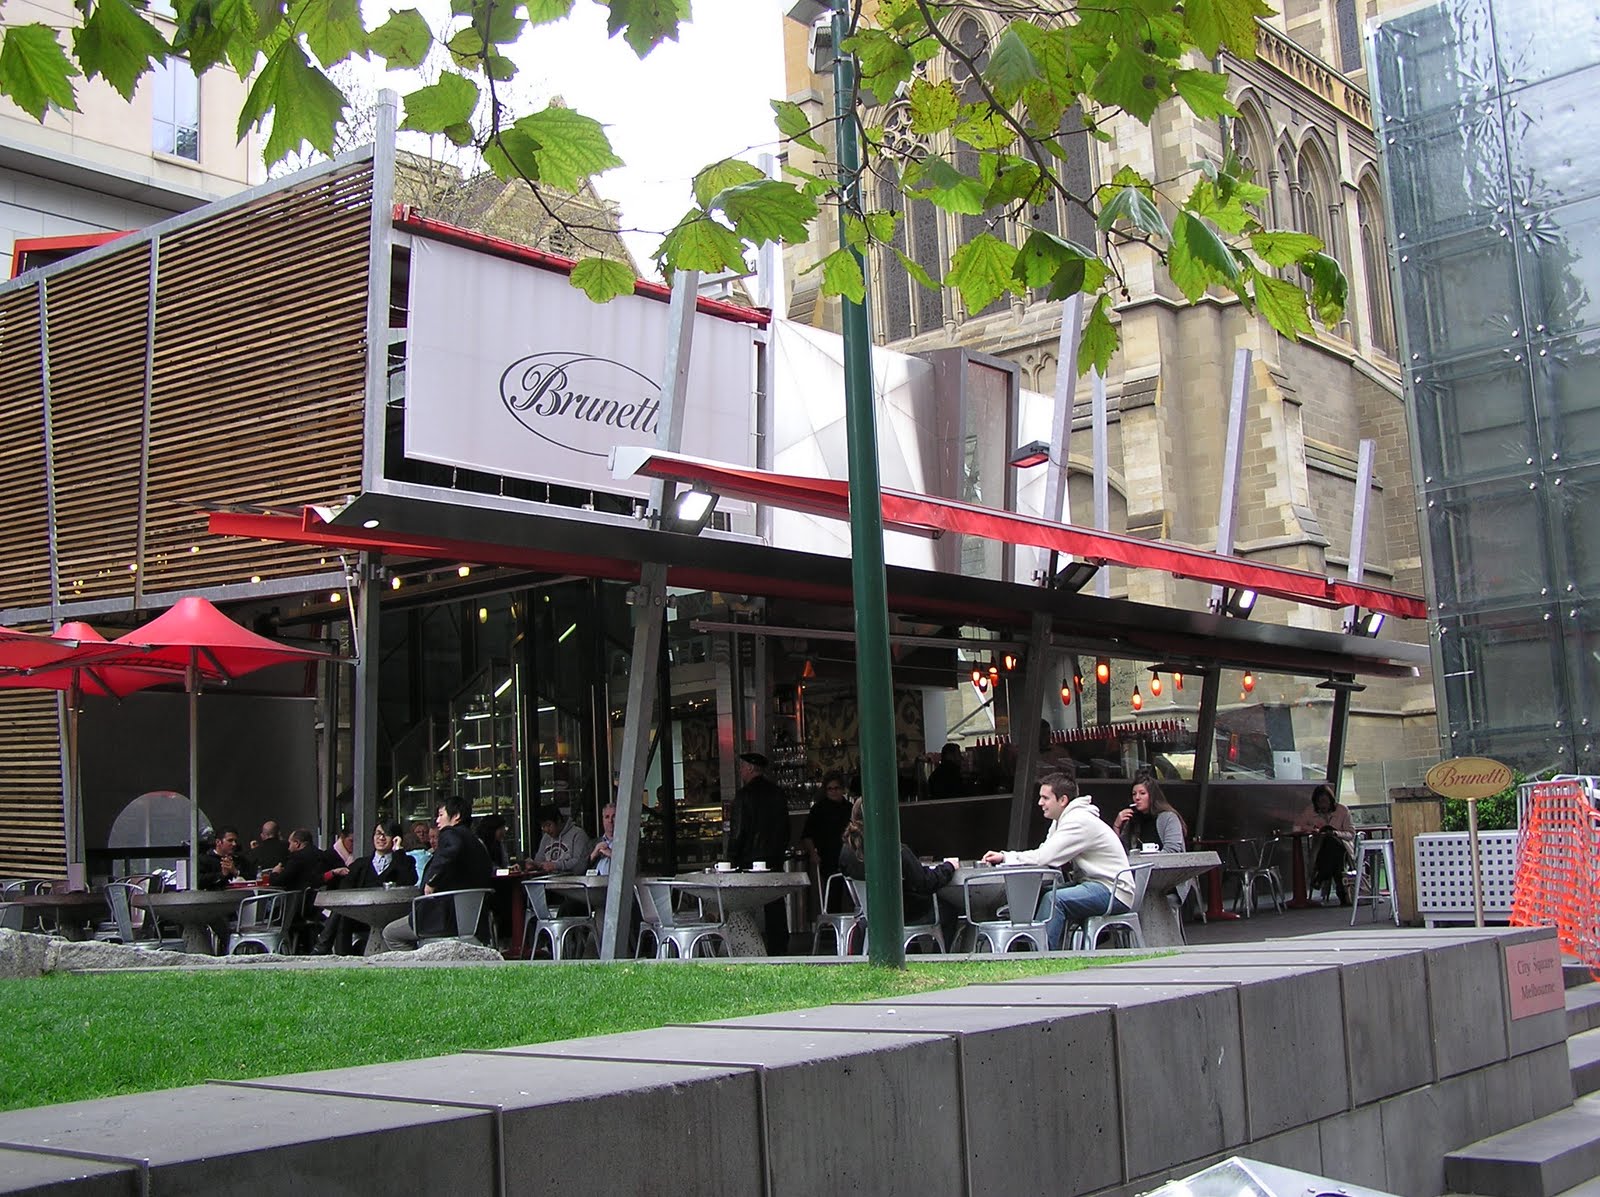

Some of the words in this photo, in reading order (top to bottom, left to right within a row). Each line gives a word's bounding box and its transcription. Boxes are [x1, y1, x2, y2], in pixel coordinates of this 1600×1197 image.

[510, 363, 661, 434] Brunett
[1432, 766, 1506, 788] Brunetti
[1516, 960, 1531, 976] City
[1532, 958, 1554, 974] Square
[1521, 983, 1555, 1000] Melbourne
